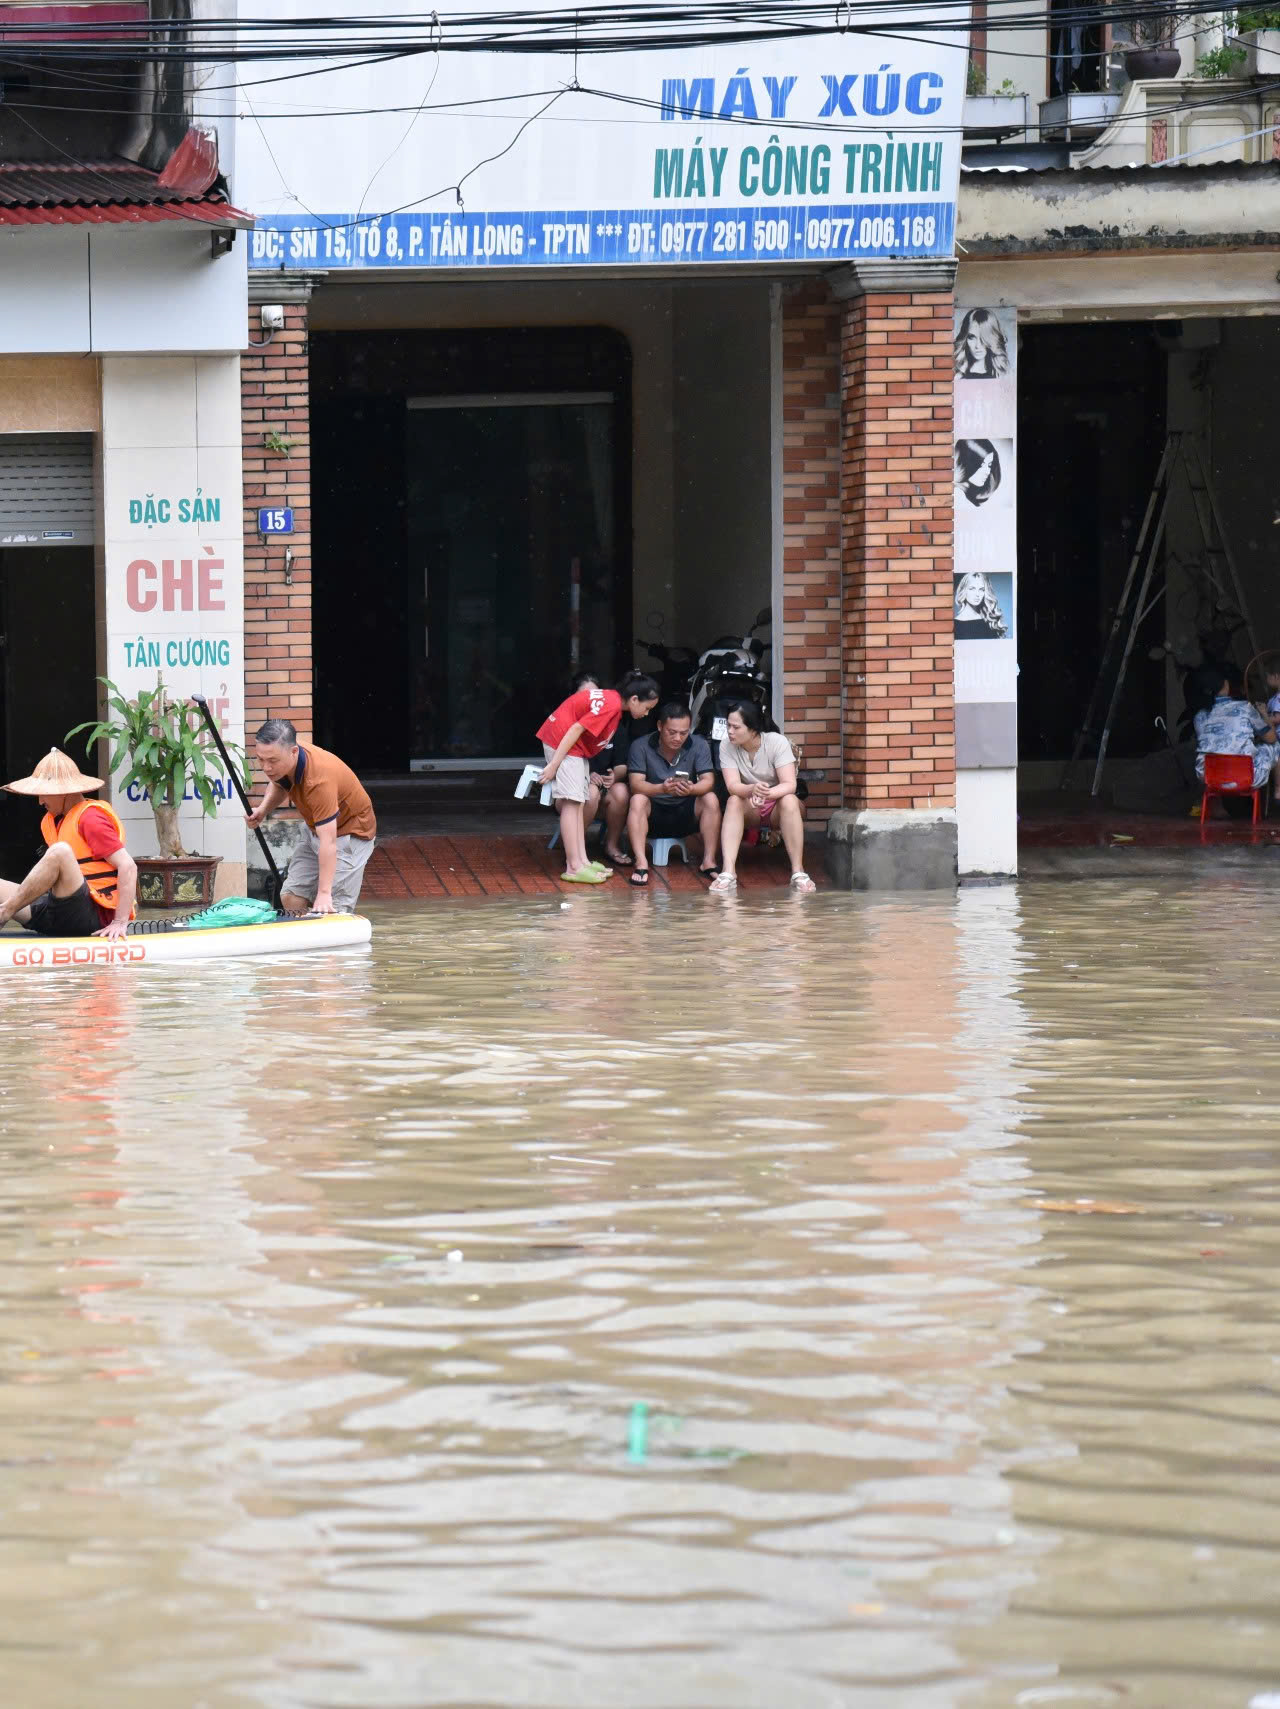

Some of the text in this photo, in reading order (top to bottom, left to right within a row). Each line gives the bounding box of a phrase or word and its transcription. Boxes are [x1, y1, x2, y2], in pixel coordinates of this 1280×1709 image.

[660, 64, 944, 121] MÁY XÚC
[653, 131, 943, 198] MÁY CÔNG TRÌNH
[252, 227, 284, 259] ĐC:
[290, 227, 317, 258] SN
[324, 226, 351, 261] 15,
[357, 214, 382, 258] TỔ
[386, 225, 403, 261] 8,
[409, 225, 424, 257] P.
[430, 219, 468, 257] TÂN
[472, 224, 523, 257] LONG
[542, 223, 590, 255] TPTN
[627, 222, 656, 254] ĐT:
[661, 221, 708, 253] 0977
[712, 220, 746, 252] 281
[753, 219, 789, 251] 500
[807, 215, 936, 250] 0977.006.168
[128, 487, 220, 529] ĐẶC SẢN
[266, 511, 286, 530] 15
[126, 545, 226, 613] CHÈ
[124, 636, 230, 668] TÂN CƯƠNG
[12, 944, 147, 967] GO BOARD
